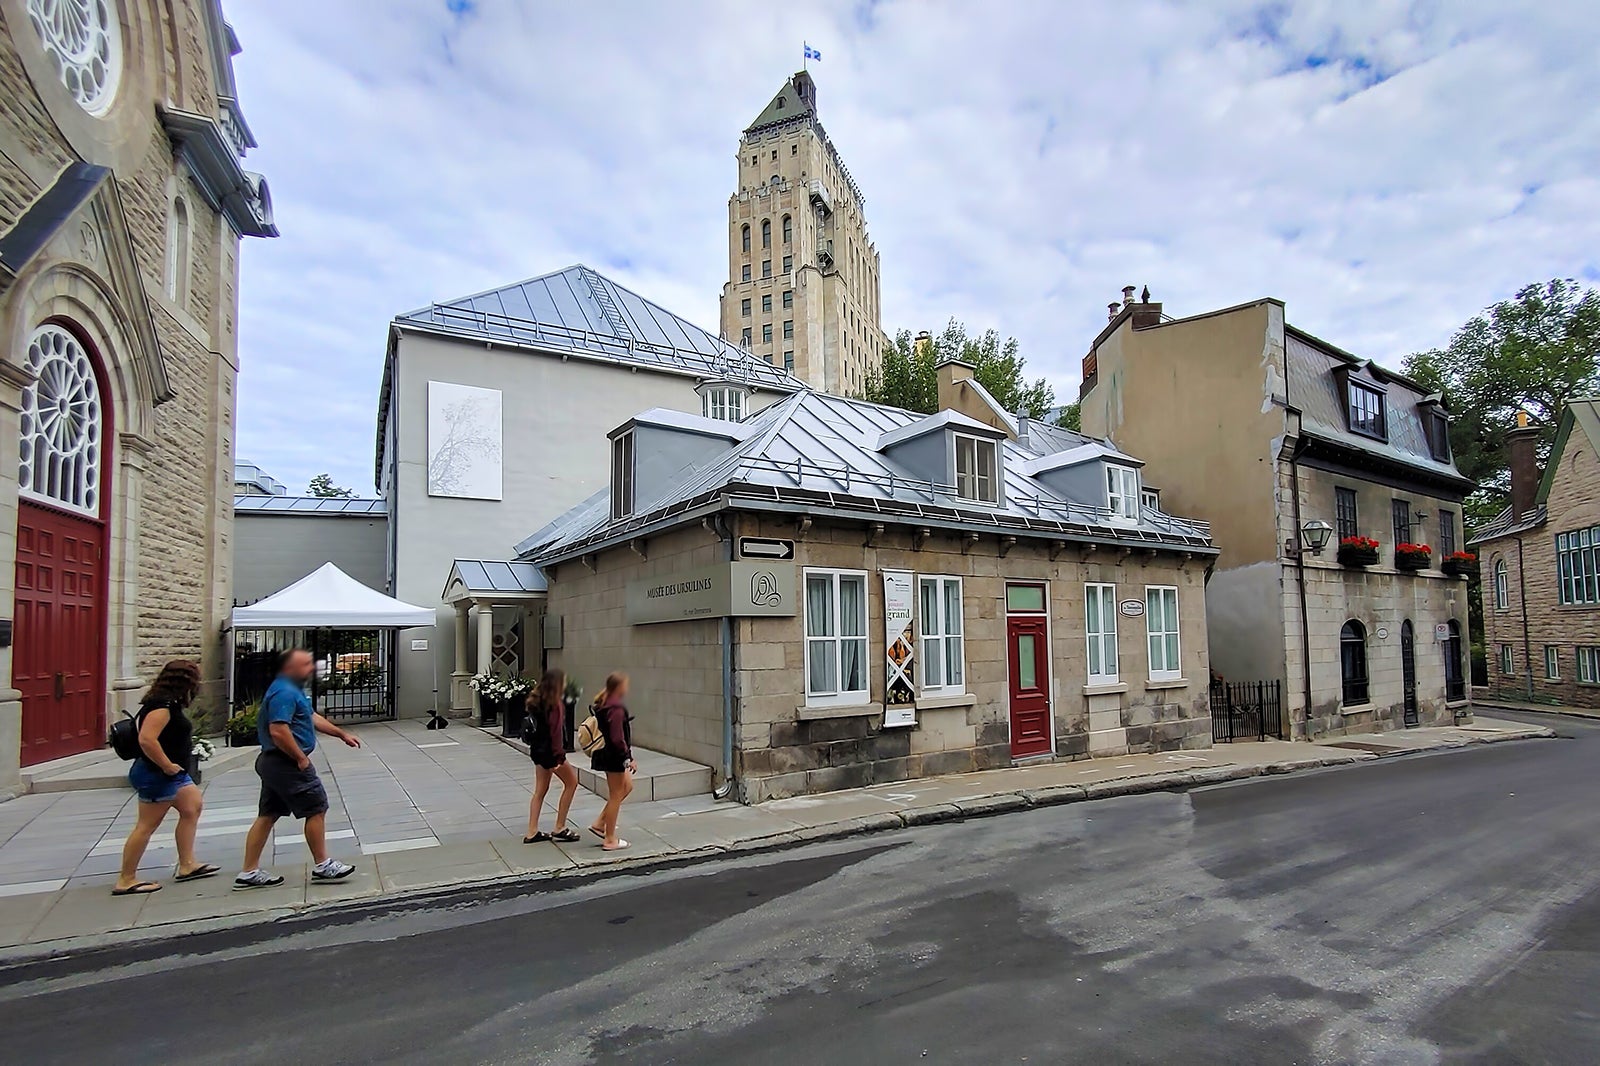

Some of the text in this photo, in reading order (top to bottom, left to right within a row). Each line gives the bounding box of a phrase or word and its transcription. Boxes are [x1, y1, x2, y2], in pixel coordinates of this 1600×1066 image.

[665, 584, 676, 595] DES
[677, 577, 711, 594] URSULINES
[887, 608, 910, 621] grand
